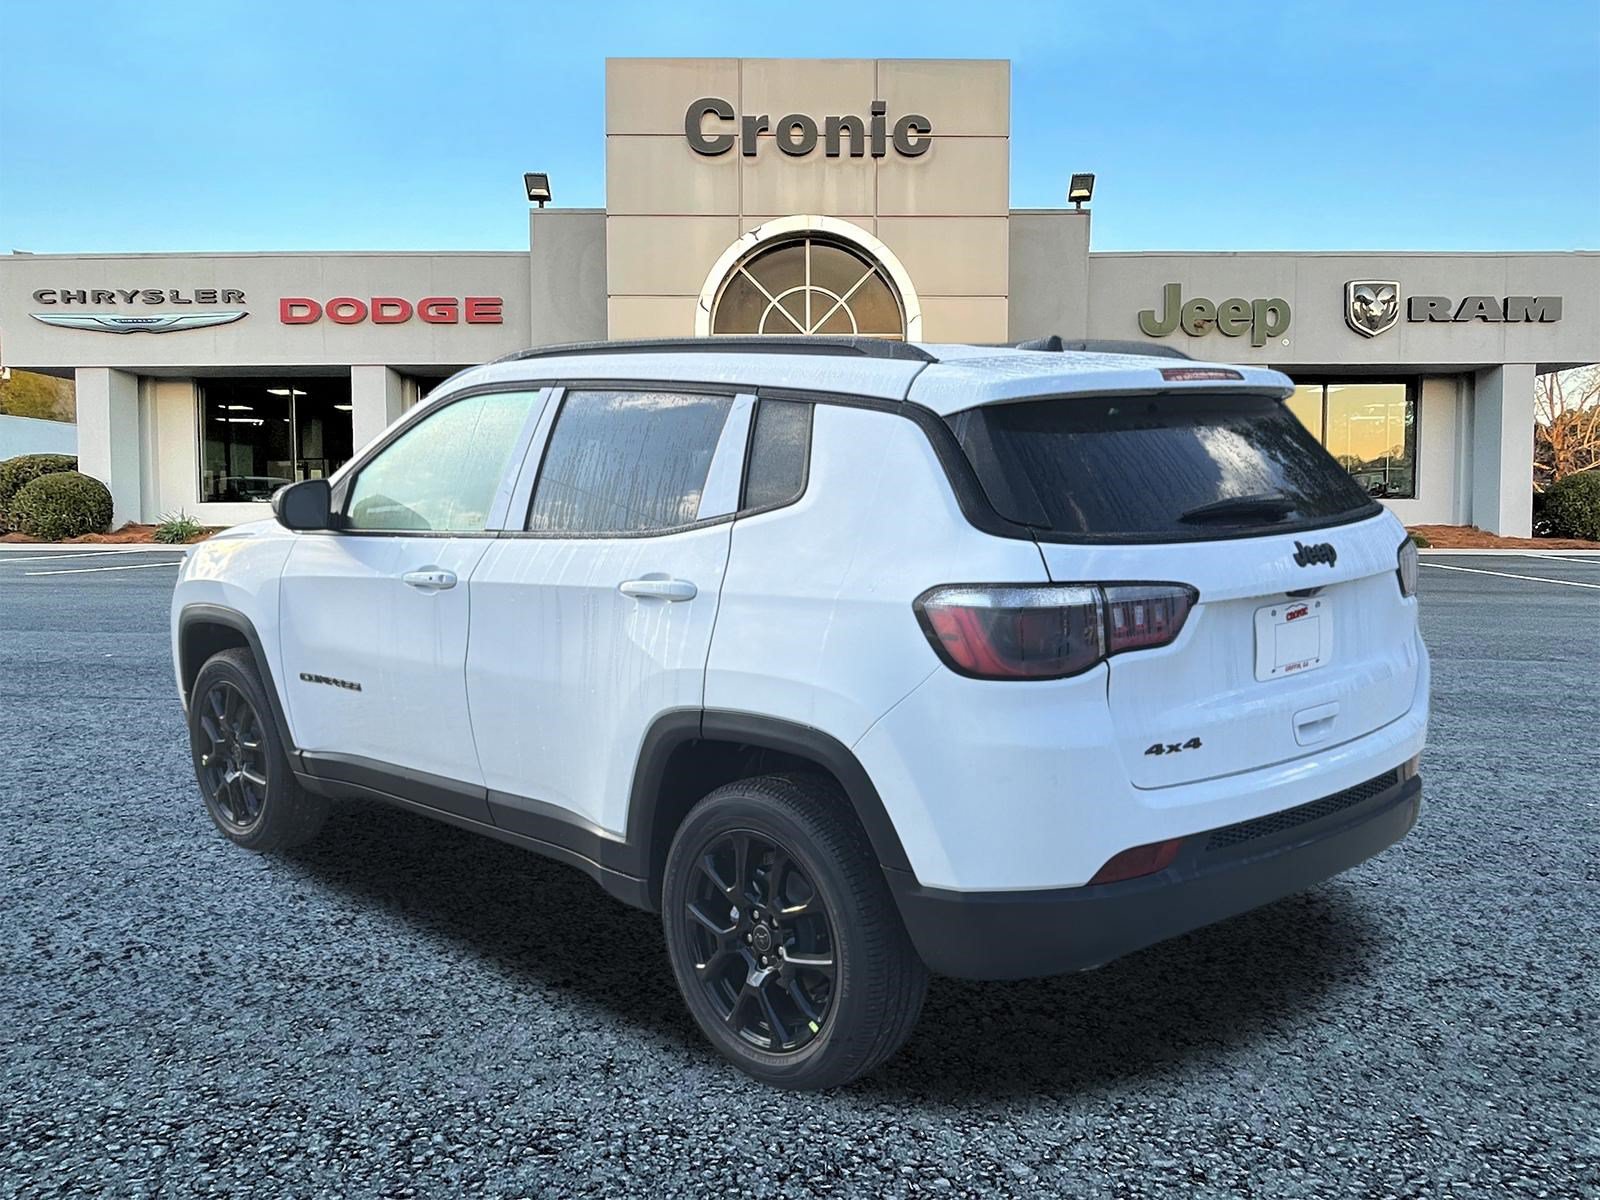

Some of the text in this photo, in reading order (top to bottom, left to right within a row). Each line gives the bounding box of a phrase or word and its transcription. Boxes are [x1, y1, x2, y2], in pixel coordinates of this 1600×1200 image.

[685, 98, 932, 157] Cronic
[32, 289, 247, 305] CHRYSLER
[1407, 296, 1563, 323] RAM
[280, 297, 504, 325] DODGE
[1138, 283, 1291, 347] Jeep
[1293, 541, 1337, 568] Jeep
[1144, 737, 1203, 755] 4x4
